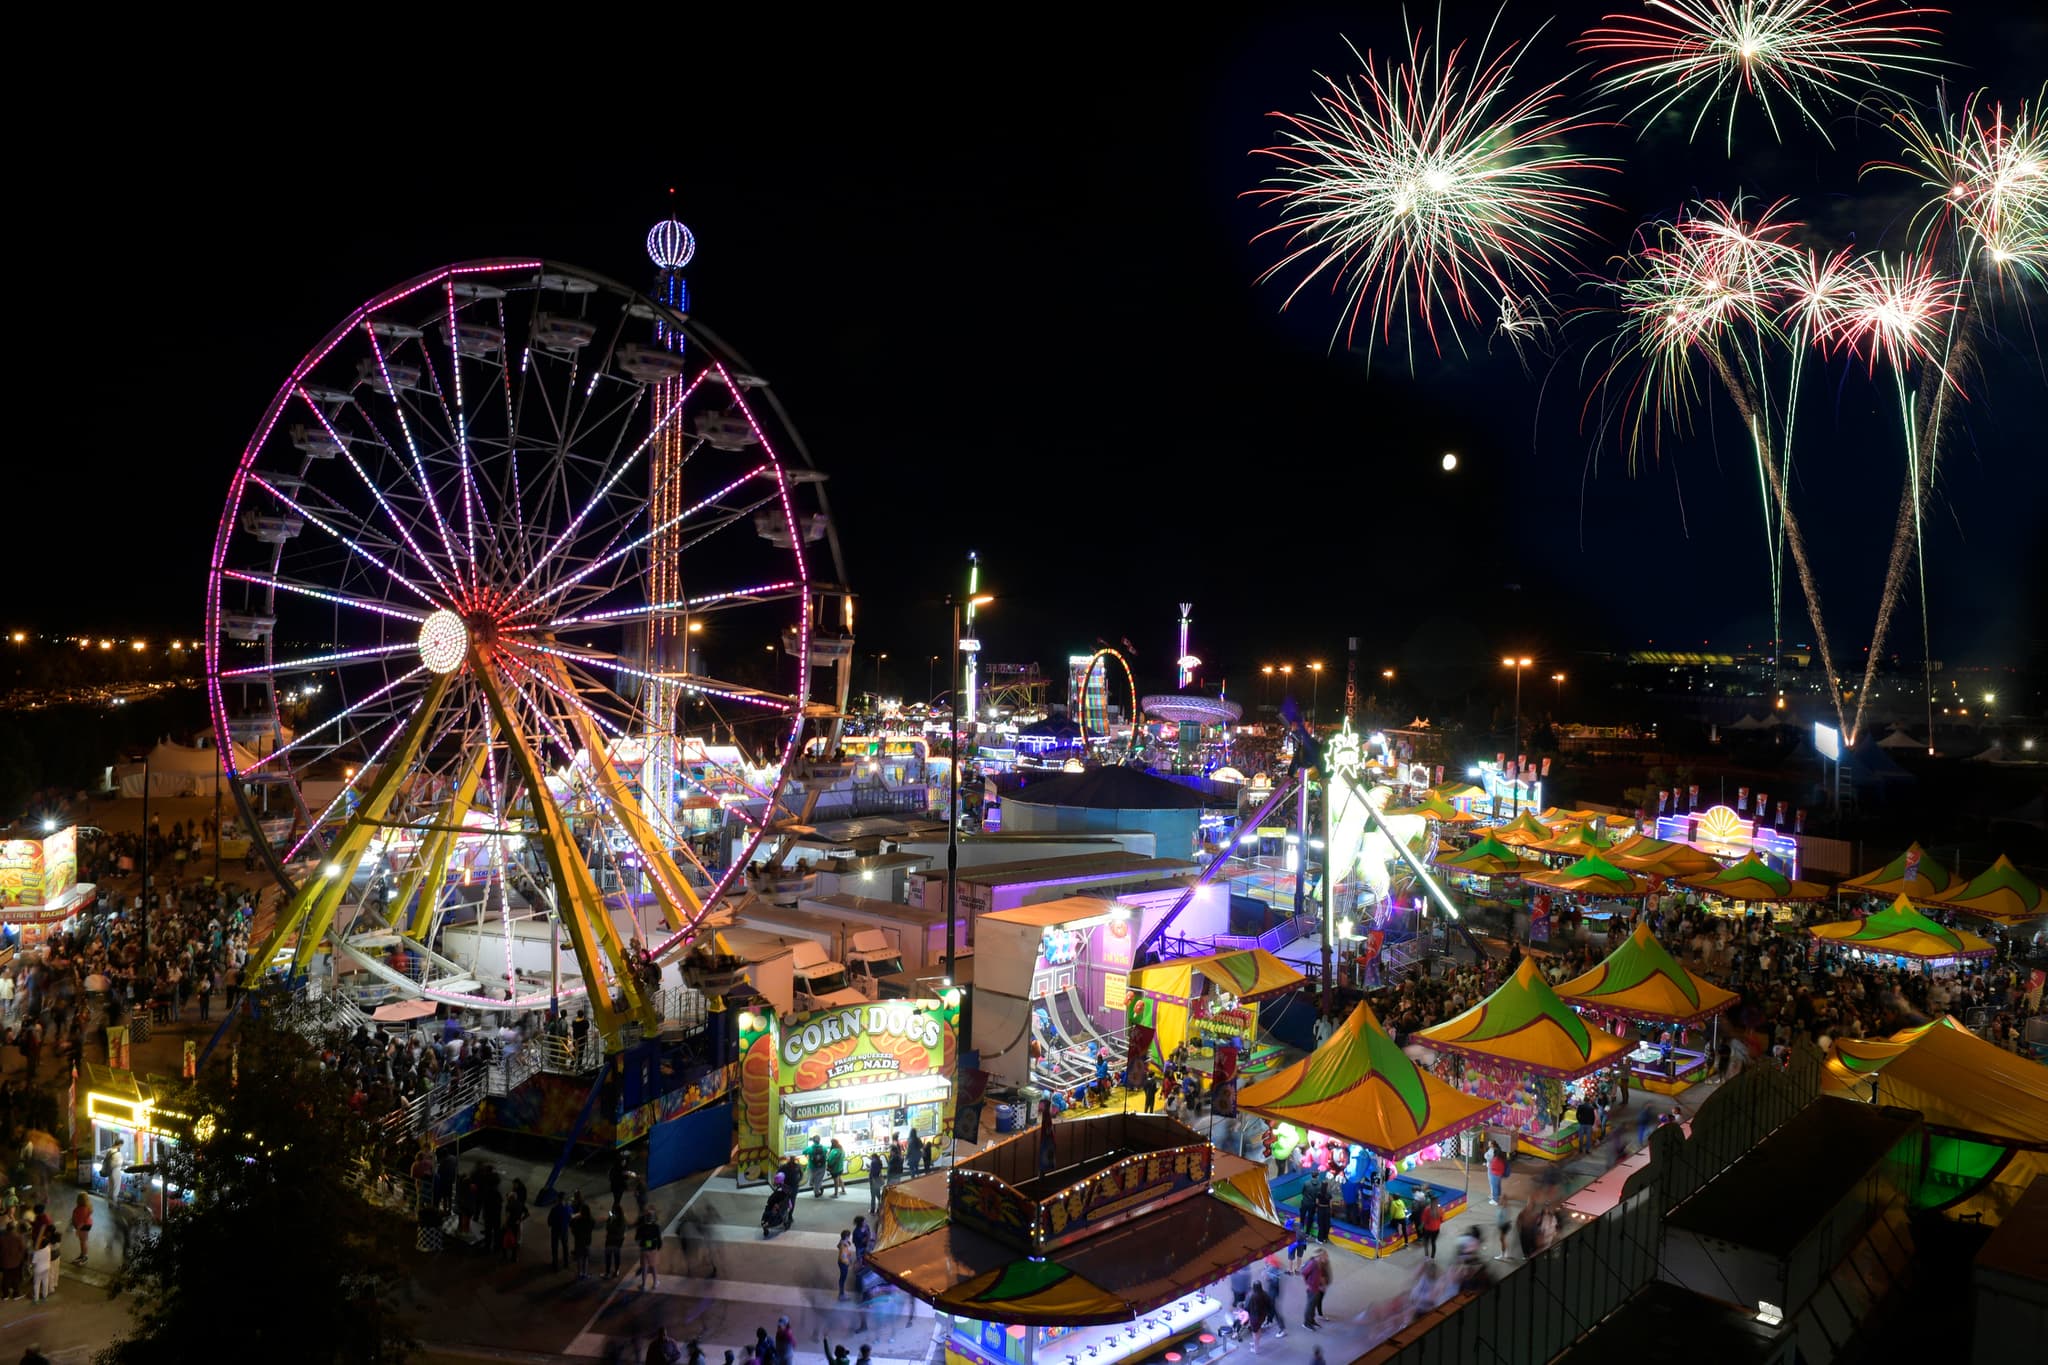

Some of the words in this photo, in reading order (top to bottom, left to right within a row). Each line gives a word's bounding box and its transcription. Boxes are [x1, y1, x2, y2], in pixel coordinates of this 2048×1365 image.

[784, 1009, 861, 1063] CORN
[868, 1007, 940, 1047] DOGS
[827, 1059, 899, 1078] LEMONADE
[796, 1106, 817, 1117] CORN
[819, 1102, 839, 1113] DOGS
[1050, 1152, 1205, 1233] WATER
